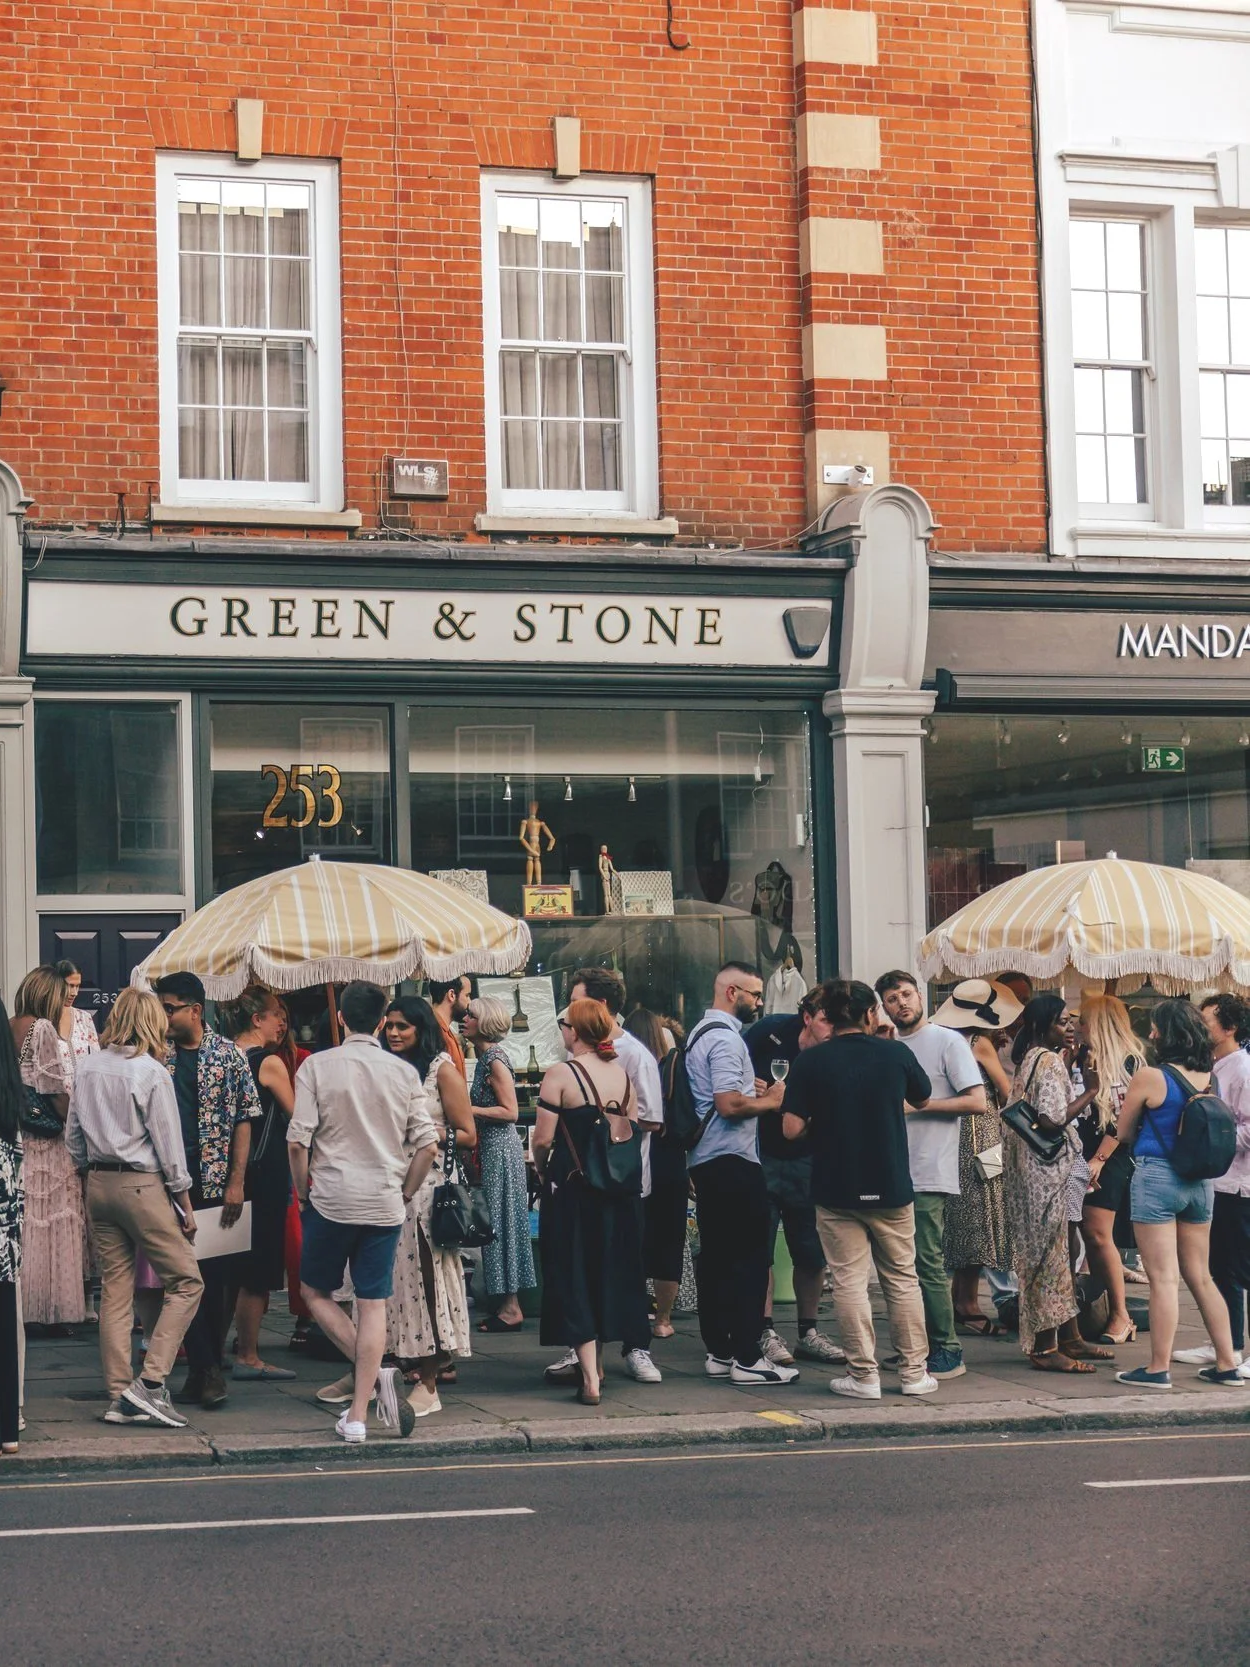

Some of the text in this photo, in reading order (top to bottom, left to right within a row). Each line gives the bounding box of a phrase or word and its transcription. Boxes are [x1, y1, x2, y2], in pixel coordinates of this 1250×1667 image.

[169, 597, 724, 646] GREEN & STONE
[261, 764, 344, 828] 253
[92, 993, 118, 1004] 253
